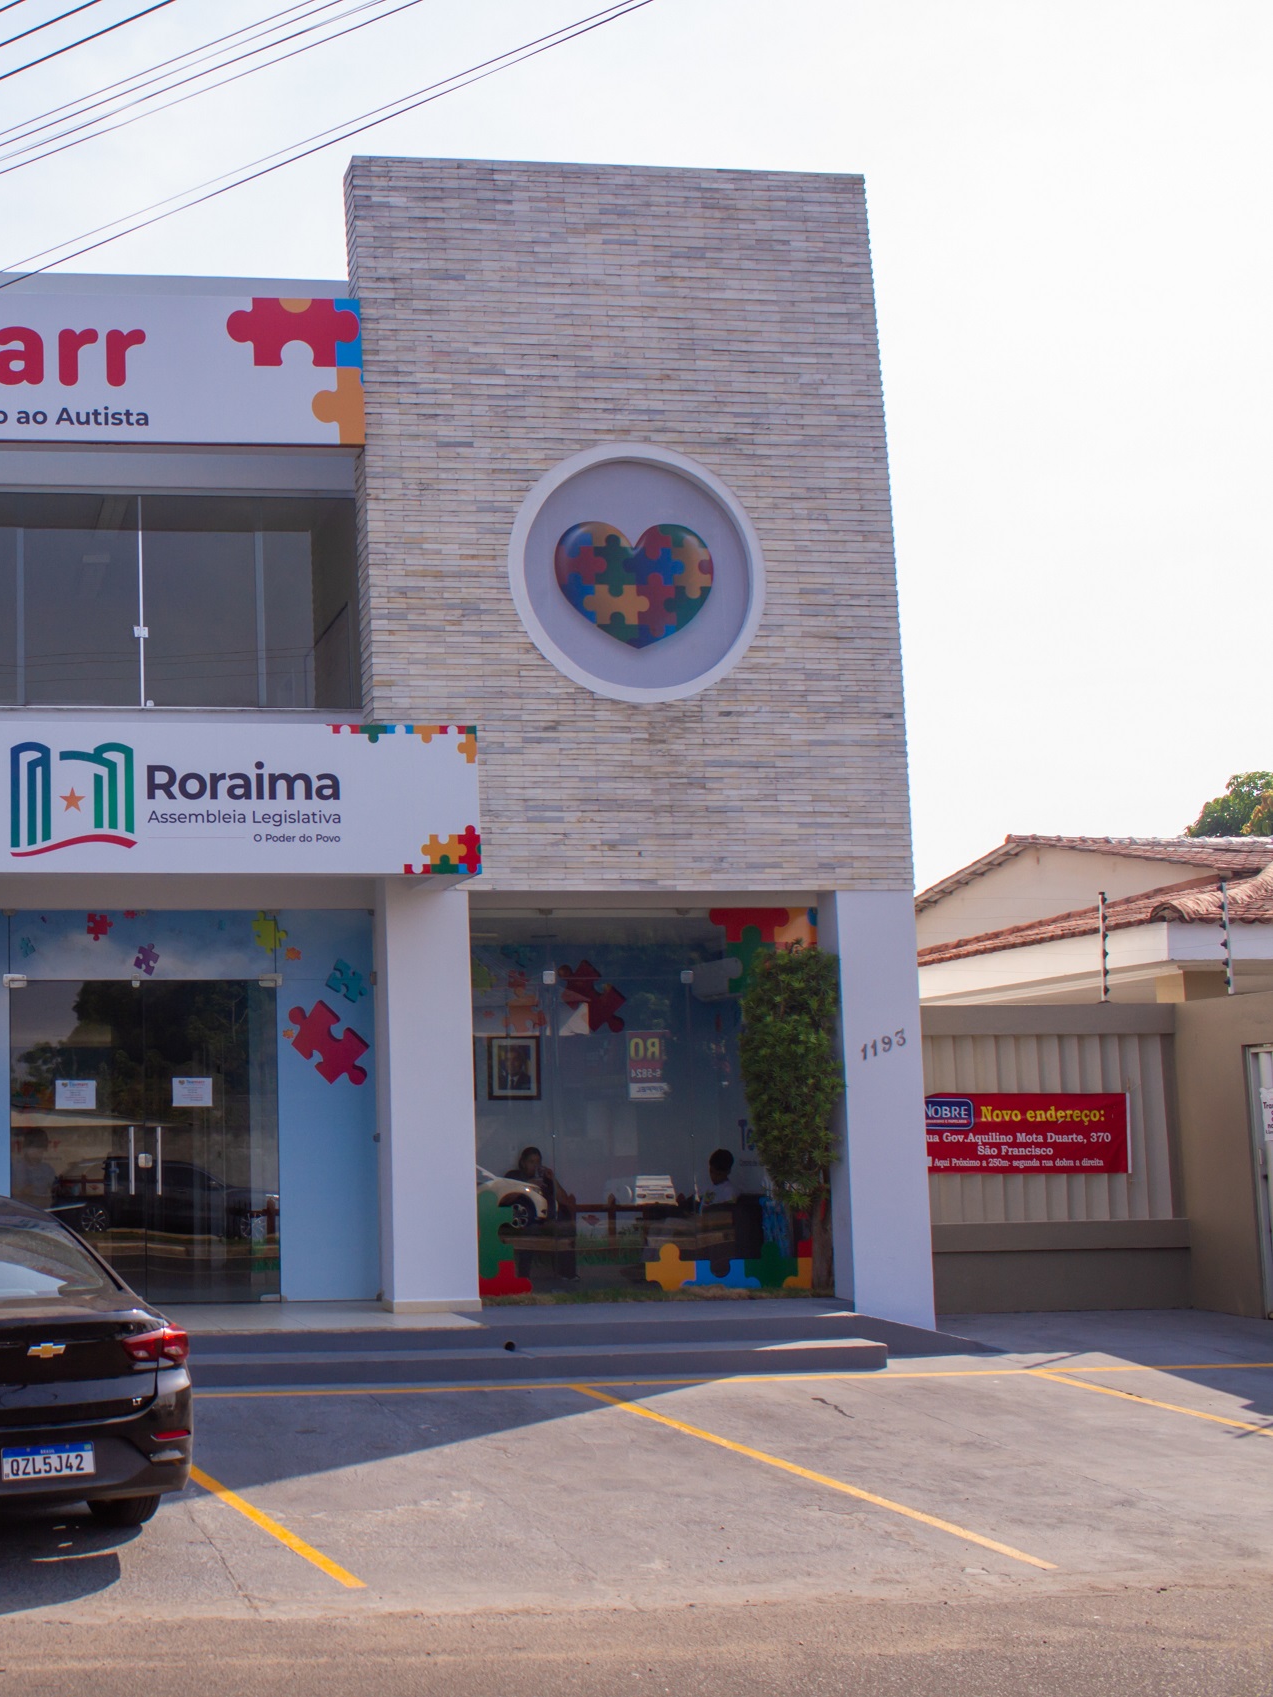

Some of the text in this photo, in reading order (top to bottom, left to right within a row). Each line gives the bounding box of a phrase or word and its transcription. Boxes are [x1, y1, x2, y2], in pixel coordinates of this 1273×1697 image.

[16, 409, 48, 425] ao
[55, 406, 149, 427] Autista
[147, 761, 341, 801] Roraima
[147, 810, 342, 827] Assembleia Legislativa
[253, 833, 341, 843] O Poder do Povo
[860, 1027, 907, 1061] 1193
[924, 1103, 969, 1118] NOBRE
[980, 1105, 1105, 1125] Novo endereço:
[925, 1134, 940, 1143] ua
[1016, 1132, 1044, 1143] Mota
[1046, 1132, 1088, 1144] Duarte,
[1090, 1132, 1111, 1143] 370
[977, 1145, 1054, 1156] São Francisco
[934, 1158, 950, 1169] Aqui
[951, 1158, 981, 1167] Próximo
[1012, 1158, 1040, 1169] segunda
[1055, 1158, 1075, 1167] dobra
[1081, 1158, 1104, 1167] direita
[132, 1397, 142, 1406] LT
[10, 1453, 85, 1477] QZL5J42
